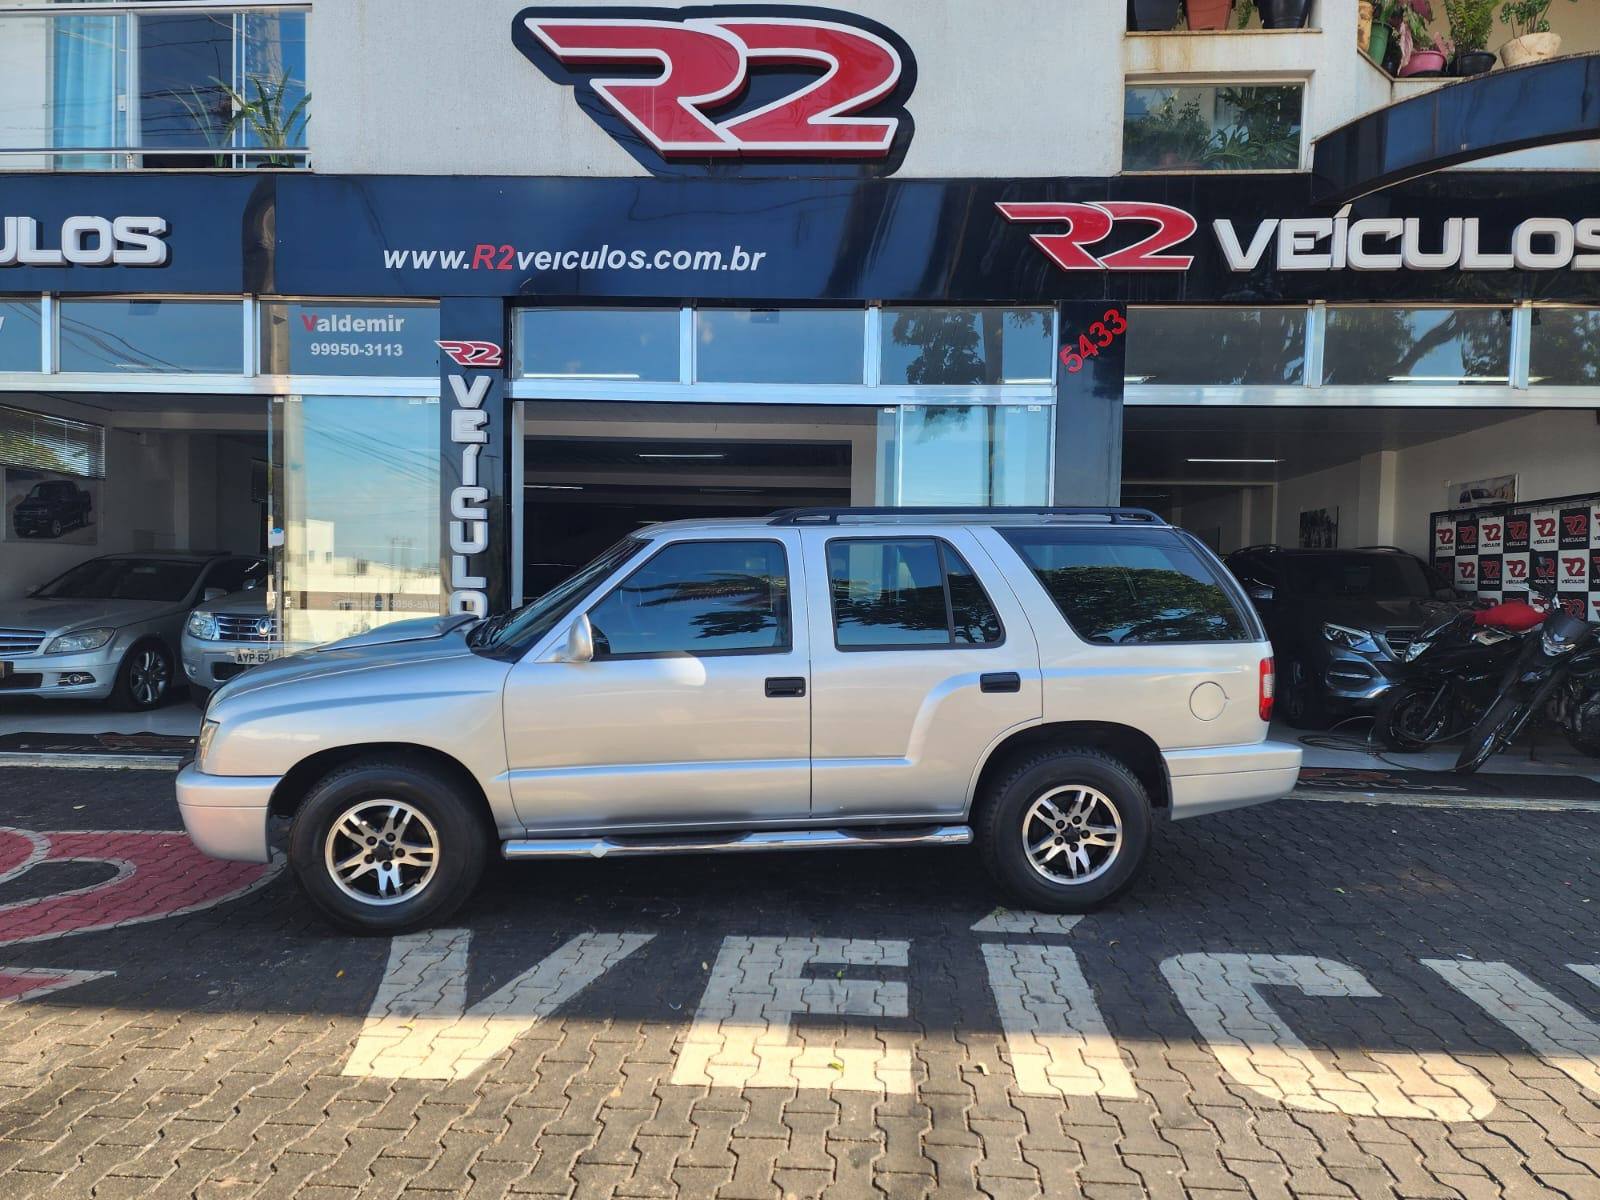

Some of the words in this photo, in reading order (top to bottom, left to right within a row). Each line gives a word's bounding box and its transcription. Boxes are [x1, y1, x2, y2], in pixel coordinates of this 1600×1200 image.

[524, 17, 902, 158] R2
[994, 200, 1198, 272] R2
[383, 244, 767, 271] www.R2veiculos.com.br
[301, 314, 405, 333] Valdemir
[310, 342, 404, 357] 99950-3113
[434, 339, 502, 367] R2
[1060, 309, 1128, 374] 5433
